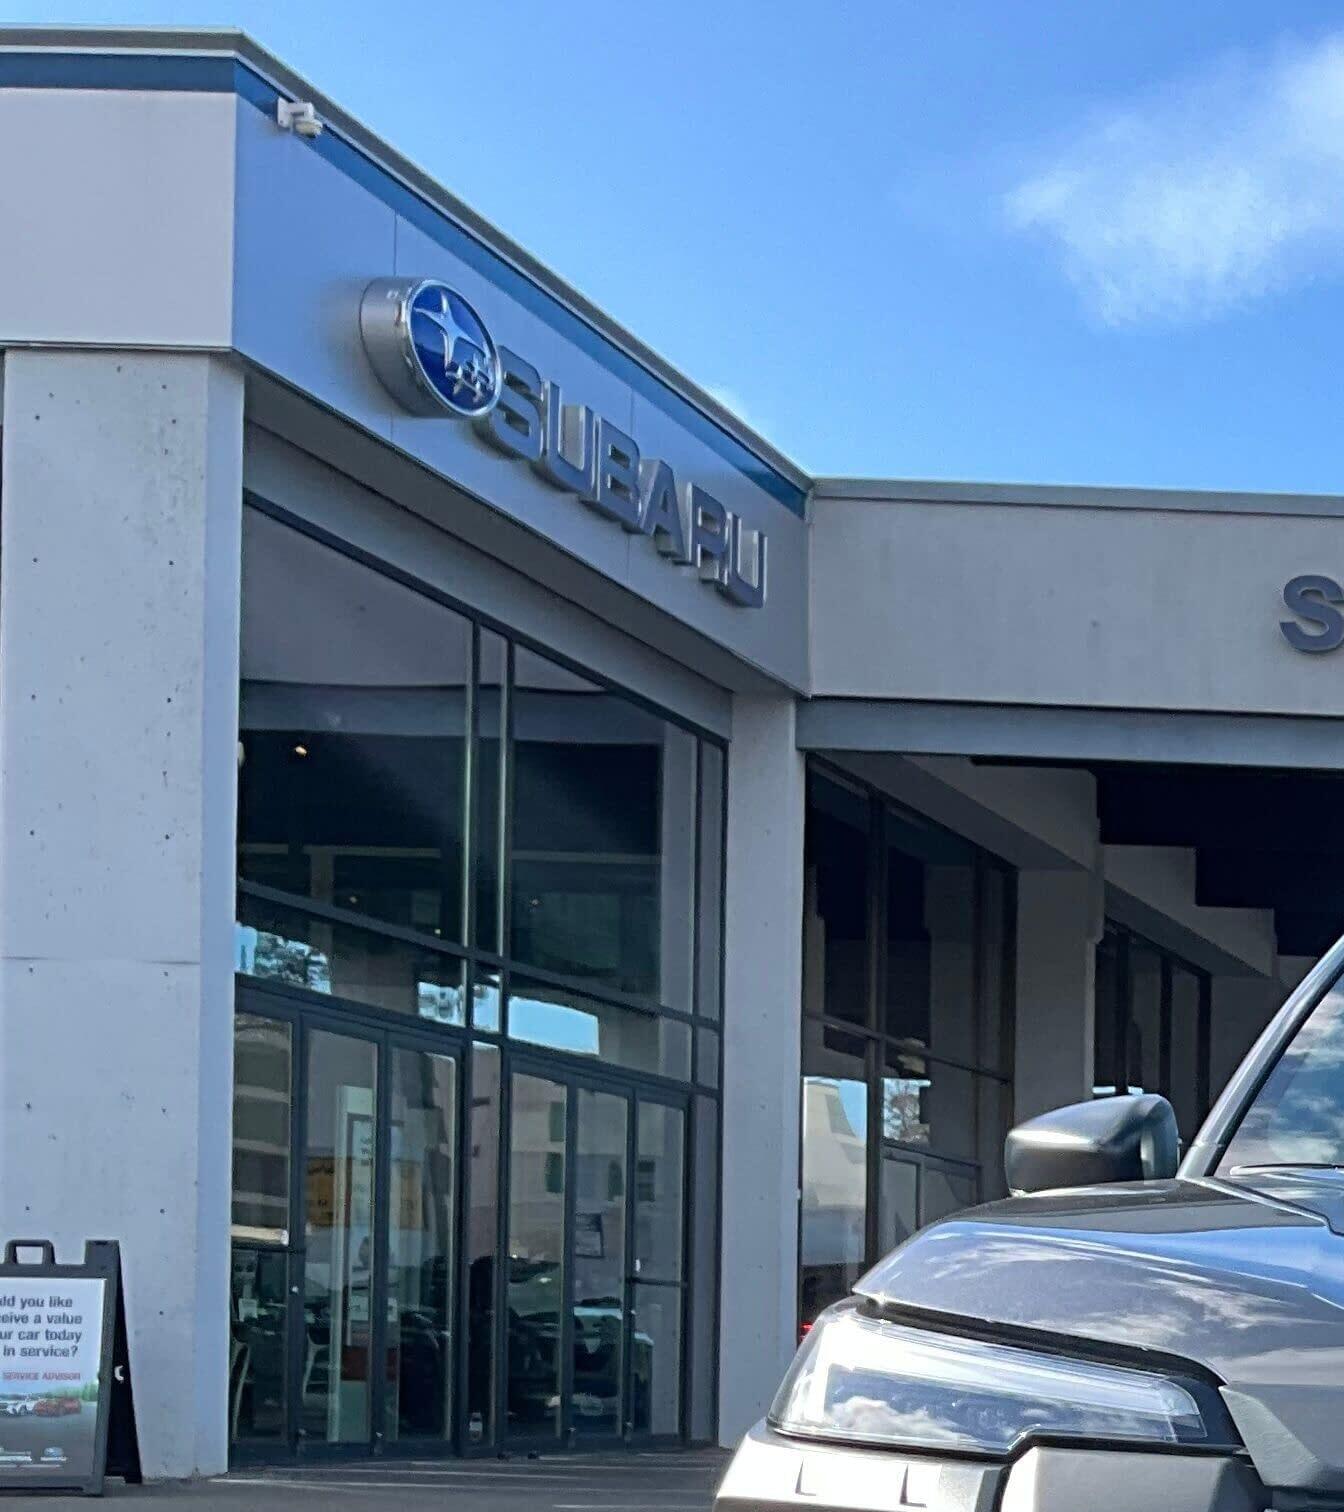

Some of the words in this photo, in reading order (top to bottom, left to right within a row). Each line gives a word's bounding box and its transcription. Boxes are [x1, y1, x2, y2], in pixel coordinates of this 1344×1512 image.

[482, 345, 768, 608] SUBARU
[20, 1298, 44, 1310] you
[49, 1296, 72, 1308] like
[0, 1313, 29, 1324] eive
[34, 1314, 41, 1324] a
[47, 1313, 82, 1324] value
[18, 1331, 40, 1341] car
[45, 1329, 82, 1343] today
[20, 1345, 78, 1357] service?
